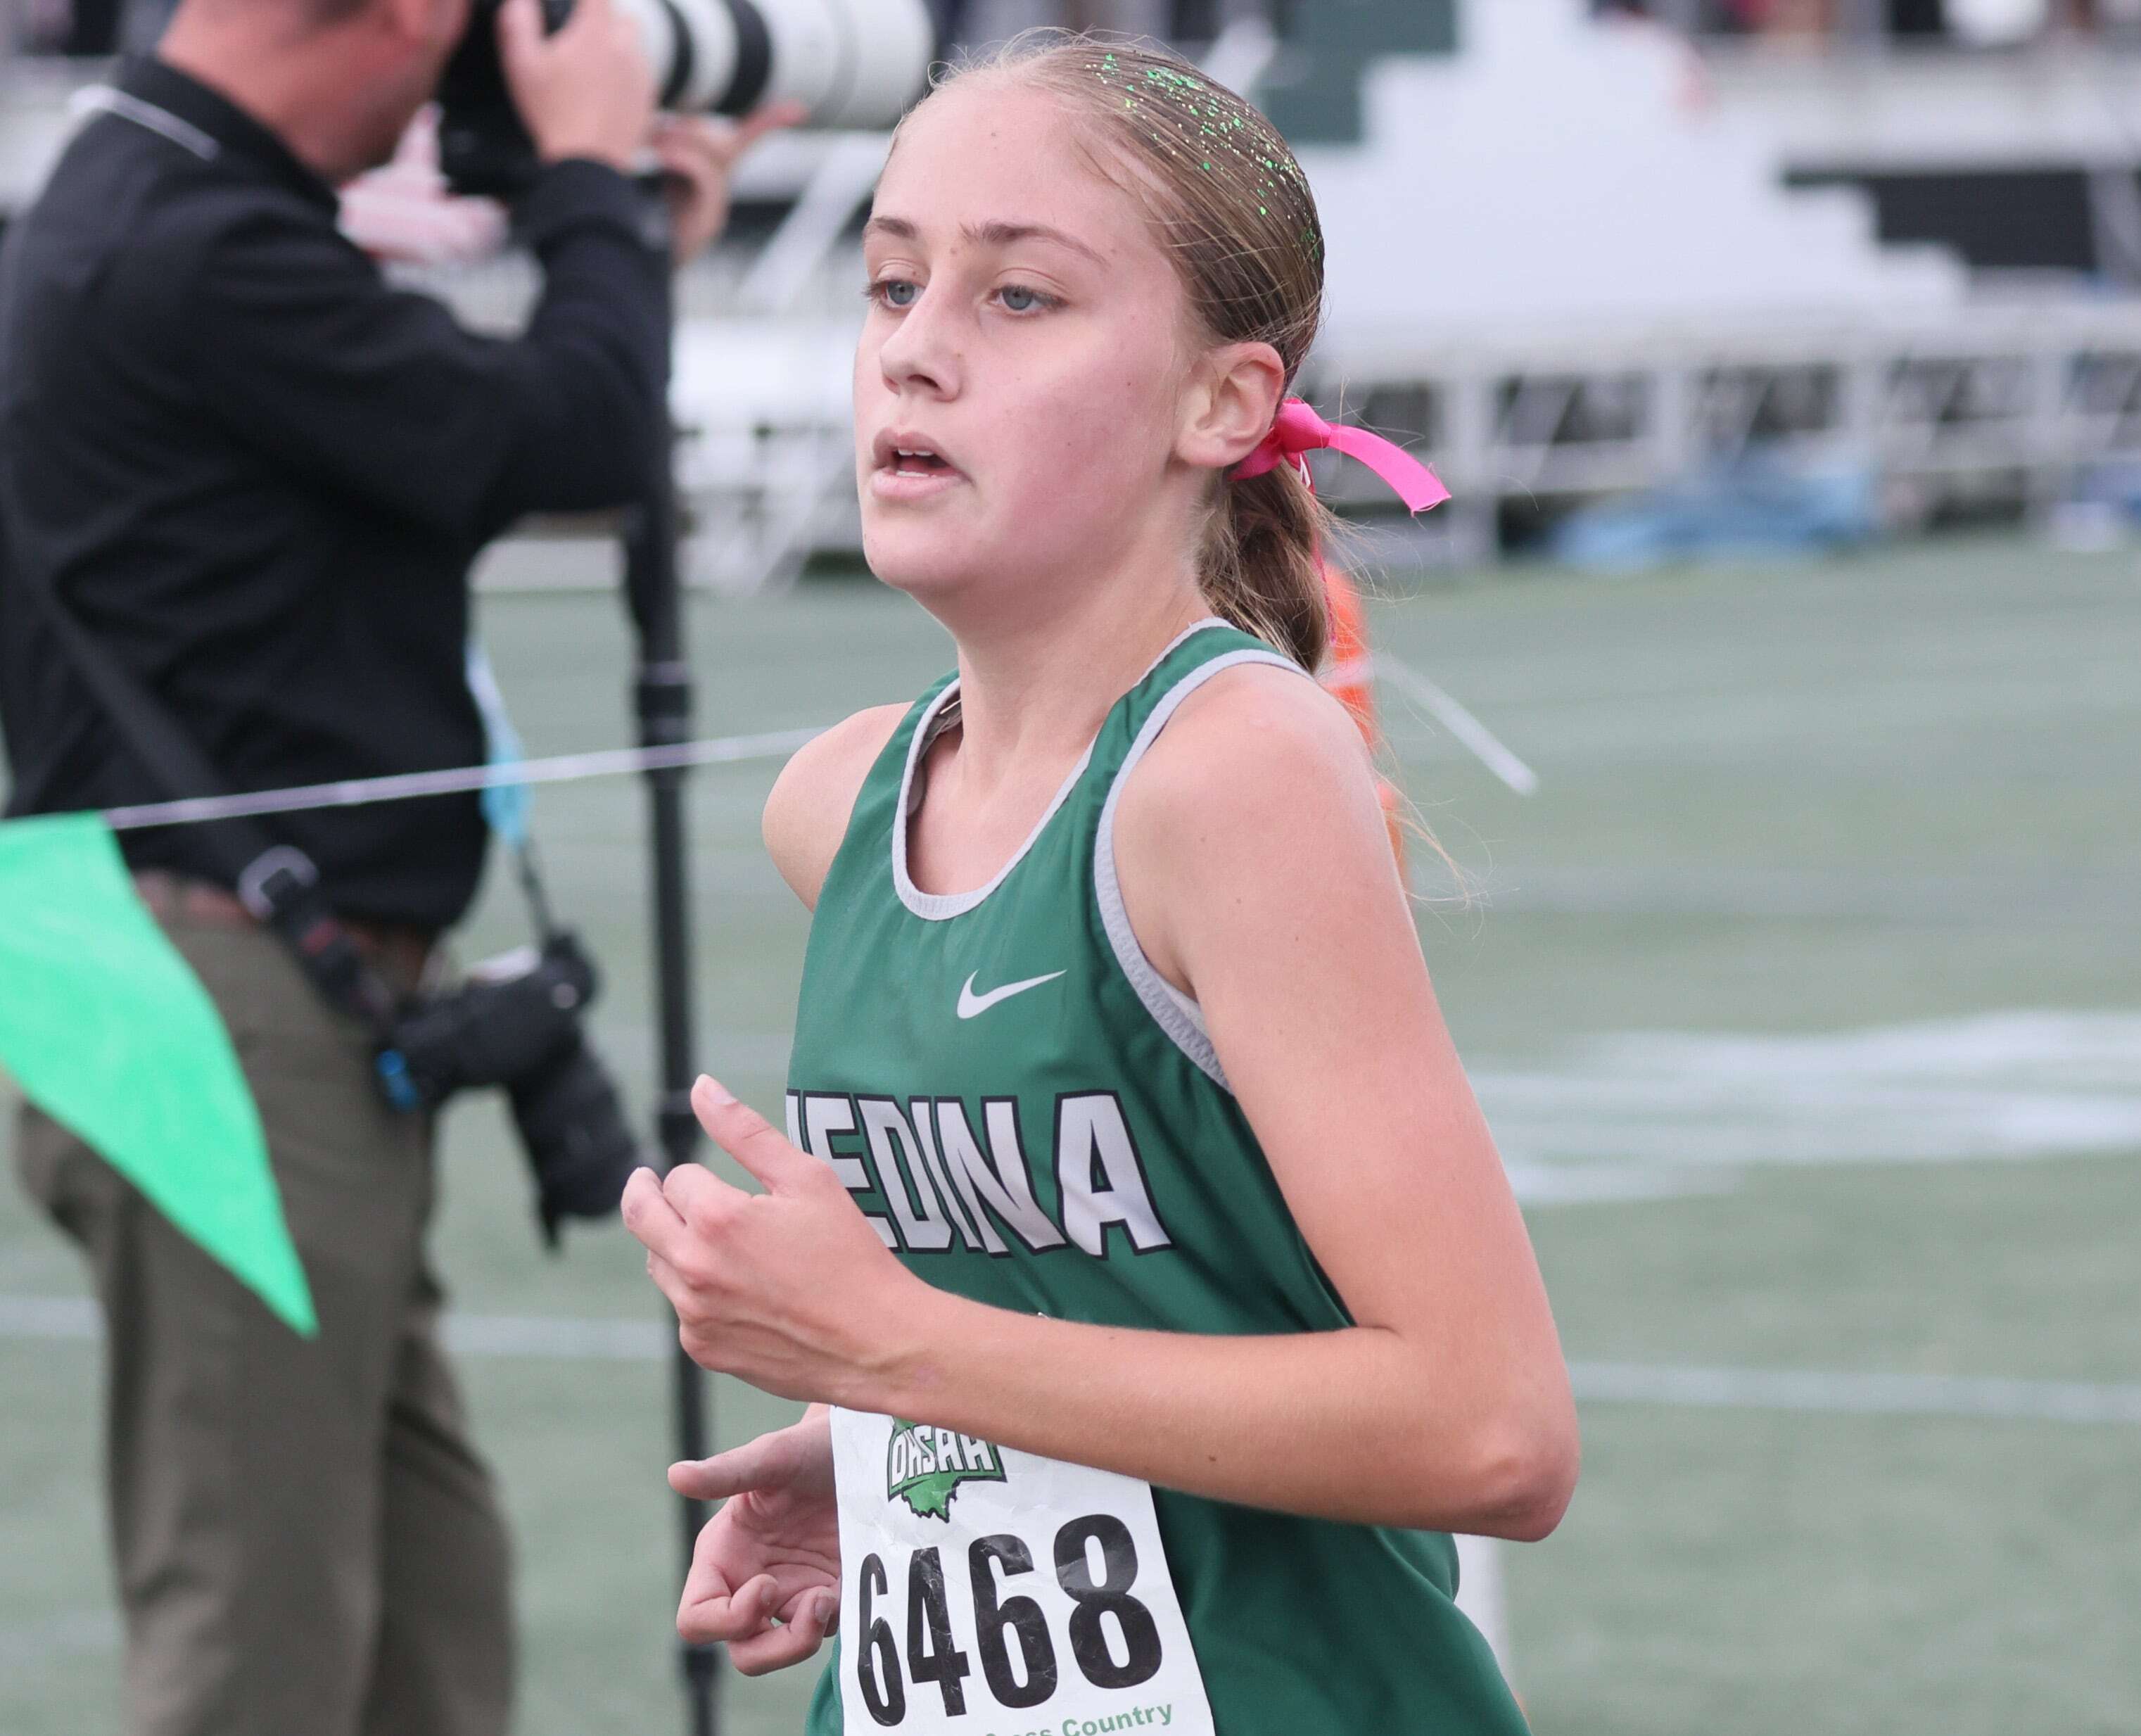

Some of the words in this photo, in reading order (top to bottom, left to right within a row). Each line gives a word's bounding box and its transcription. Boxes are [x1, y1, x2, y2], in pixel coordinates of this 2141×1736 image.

[786, 1089, 1177, 1260] EDINA
[858, 1514, 1162, 1727] 6468
[1061, 1703, 1172, 1736] Country
